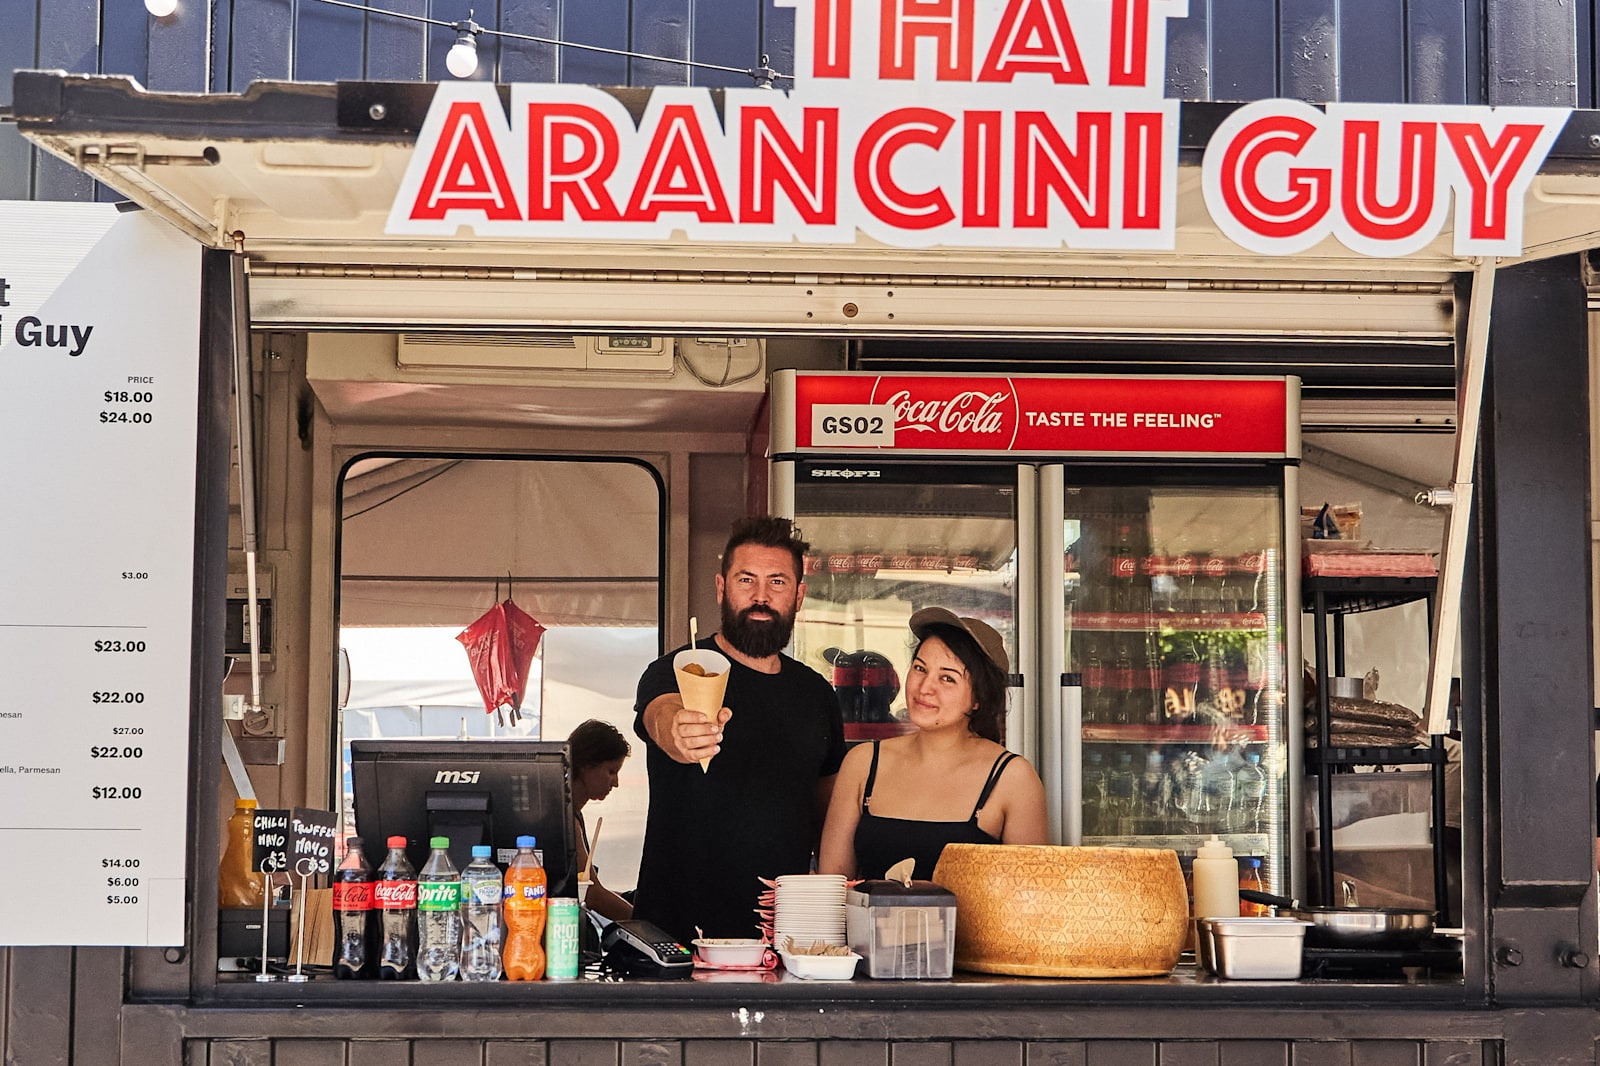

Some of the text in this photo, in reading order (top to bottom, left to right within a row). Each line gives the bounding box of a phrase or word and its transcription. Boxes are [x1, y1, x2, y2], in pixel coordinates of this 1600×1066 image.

[812, 0, 1147, 88] THAT
[408, 101, 1545, 242] ARANCINI GUY
[15, 315, 94, 357] Guy
[127, 376, 154, 384] PRICE
[104, 390, 153, 403] $18.00
[99, 410, 153, 424] $24.00
[1025, 411, 1085, 427] TASTE
[1089, 412, 1128, 428] THE
[822, 416, 884, 435] GS02
[121, 571, 149, 580] $3.00
[94, 639, 146, 653] $23.00
[92, 691, 145, 704] $22.00
[112, 727, 144, 735] $27.00
[90, 745, 143, 759] $22.00
[18, 766, 61, 774] Parmesan
[434, 770, 481, 784] msi
[92, 786, 142, 800] $12.00
[254, 816, 287, 830] CHILLI
[258, 833, 285, 847] MAYO
[295, 837, 328, 857] MAYO
[101, 858, 140, 868] $14.00
[107, 877, 139, 887] $6.00
[375, 883, 416, 901] Coca-Cola
[418, 884, 457, 904] Sprite
[106, 895, 139, 905] $5.00
